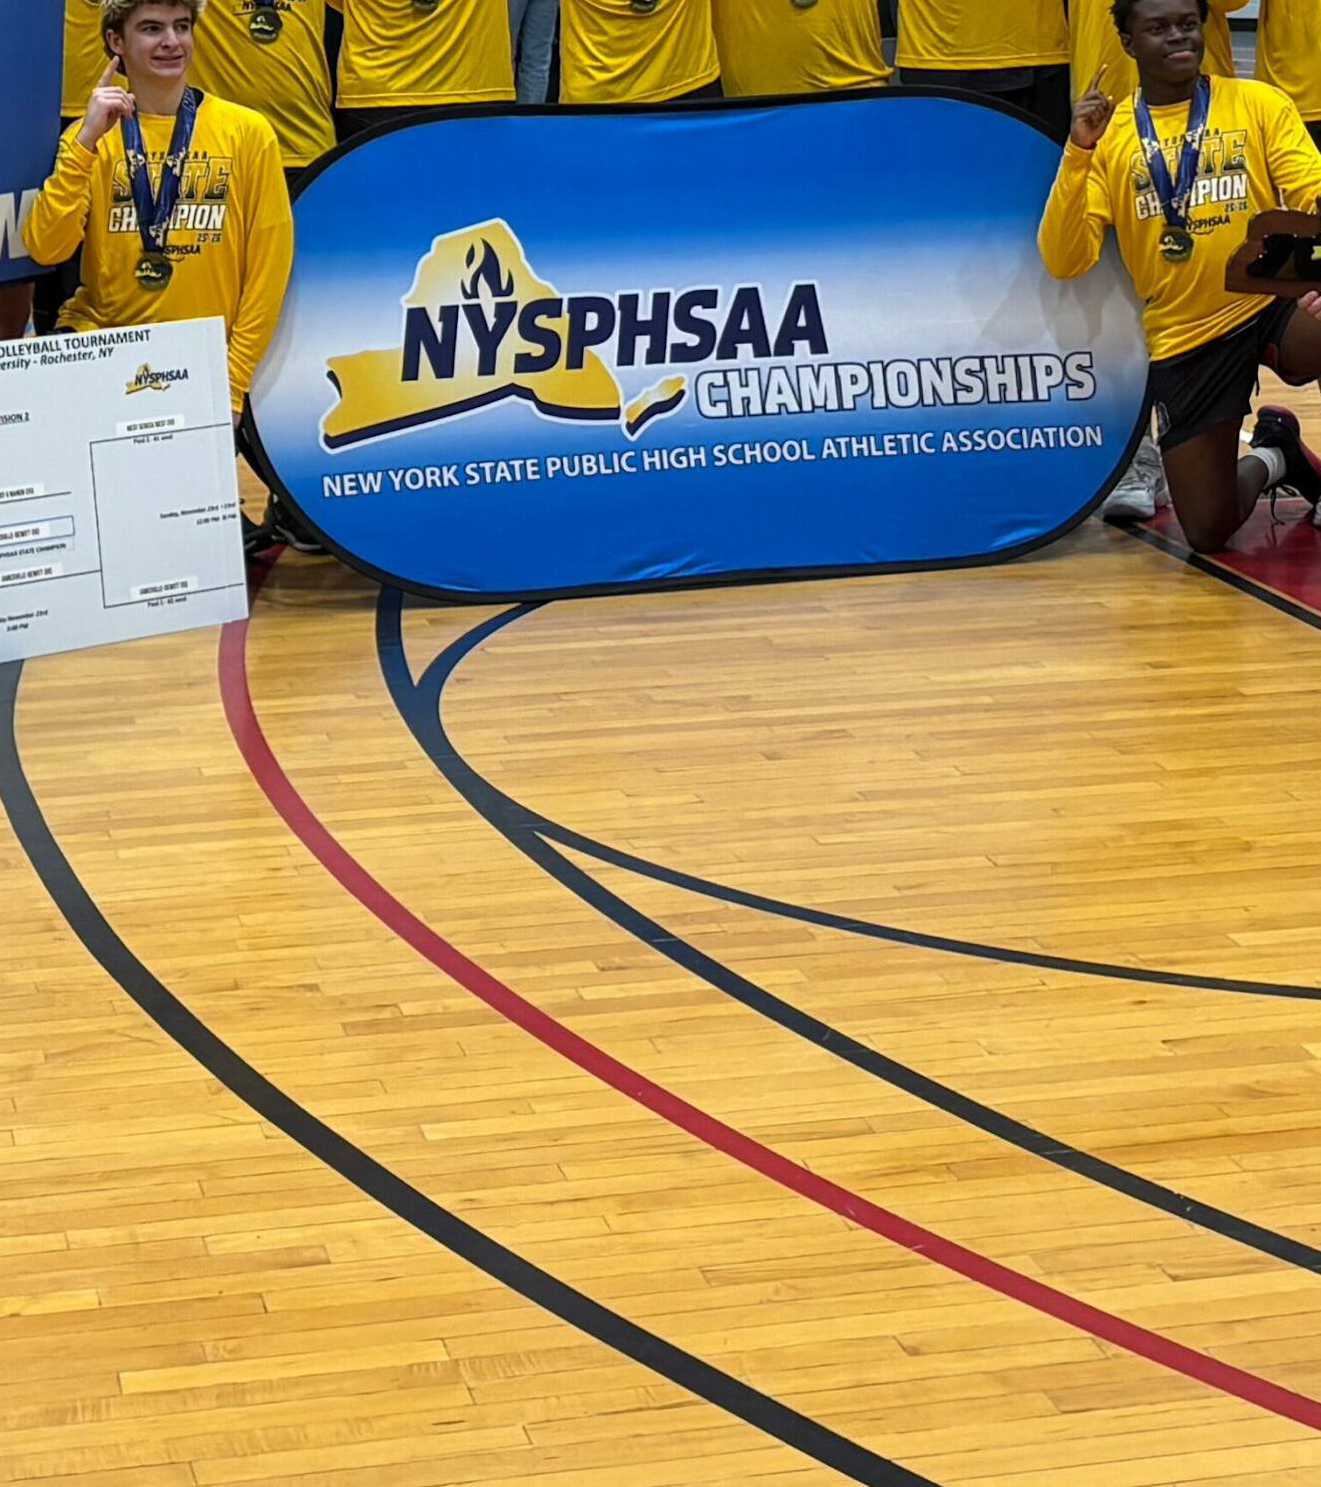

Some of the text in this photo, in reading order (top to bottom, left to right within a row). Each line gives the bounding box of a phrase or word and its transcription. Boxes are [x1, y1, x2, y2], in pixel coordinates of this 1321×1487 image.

[64, 329, 151, 350] TOURNAMENT
[401, 283, 828, 382] NYSPHSAA
[40, 350, 96, 366] Rochester,
[98, 347, 114, 358] NY
[134, 368, 189, 386] NYSPHSAA
[695, 351, 1096, 420] CHAMPIONSHIPS
[322, 424, 1103, 499] NEW YORK STATE PUBLIC HIGH SCHOOL ATHLETIC ASSOCIATION
